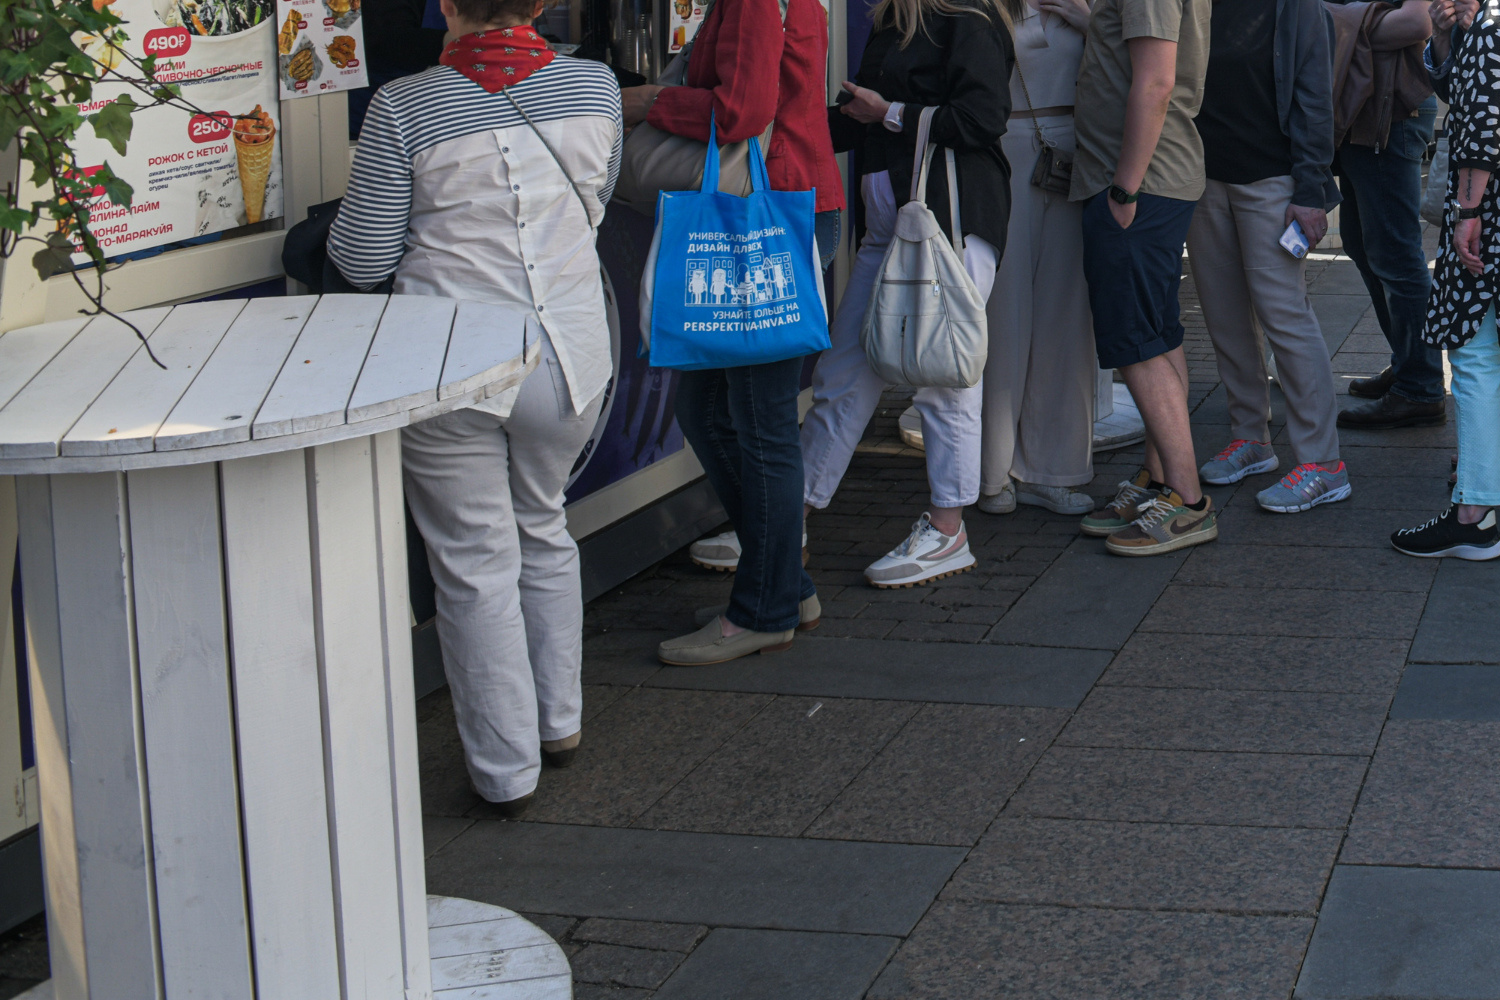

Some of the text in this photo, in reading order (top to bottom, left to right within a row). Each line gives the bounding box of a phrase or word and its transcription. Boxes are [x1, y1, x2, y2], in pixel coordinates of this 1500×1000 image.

[148, 142, 229, 166] РОЖОК С КЕТОЙ
[88, 200, 160, 224] АЛИНА-ЛАЙМ
[73, 223, 173, 254] МГО-МАРАКУЙЯ
[687, 242, 731, 254] ДИЗАЙН
[712, 309, 752, 319] УЗНАЙТЕ
[786, 302, 799, 312] НА
[683, 312, 801, 332] PERSPEKTIVA-INVA.RU
